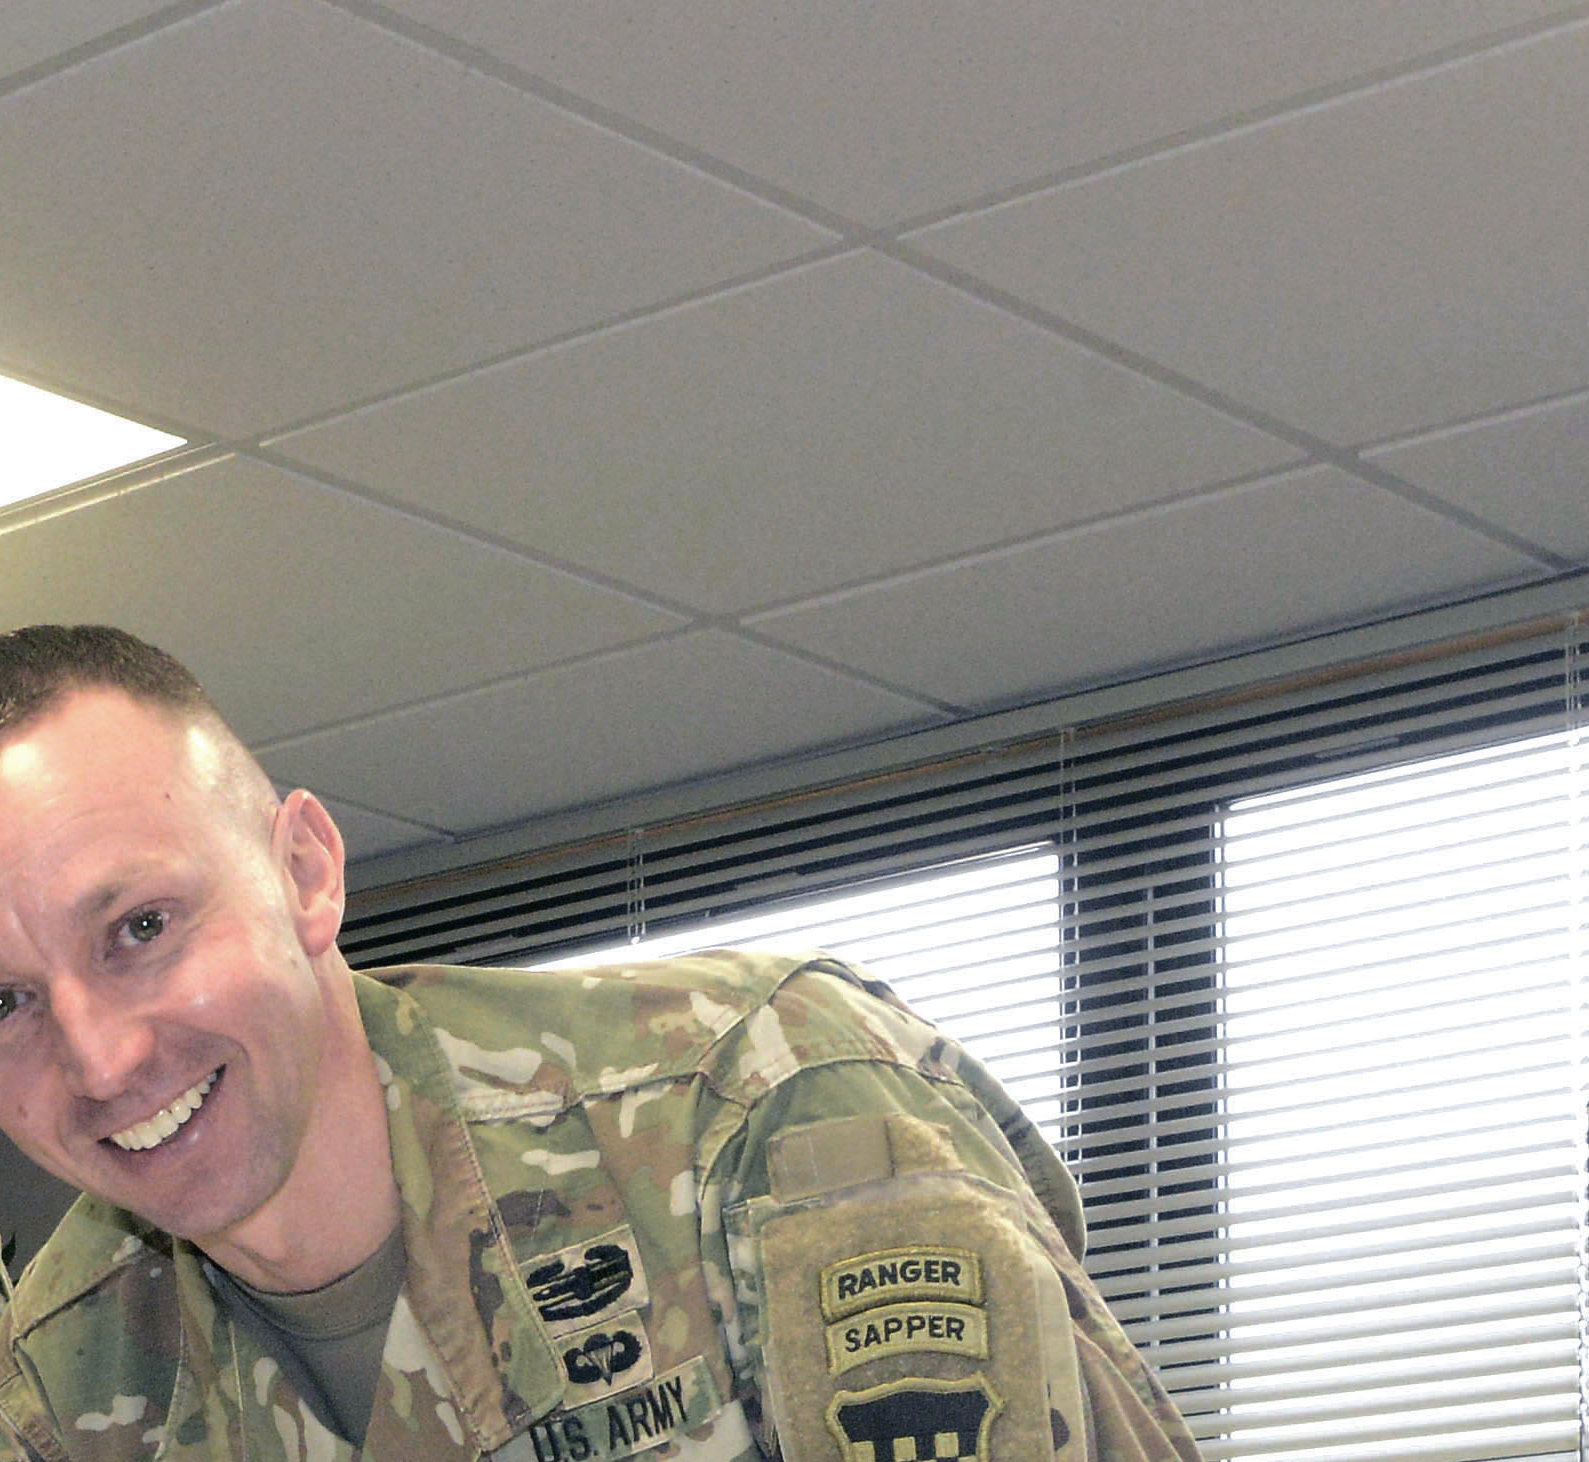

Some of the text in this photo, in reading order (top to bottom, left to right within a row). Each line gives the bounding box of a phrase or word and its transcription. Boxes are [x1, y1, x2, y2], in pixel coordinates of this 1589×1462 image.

[837, 1259, 962, 1301] RANGER
[844, 1314, 966, 1354] SAPPER
[606, 1375, 688, 1451] ARMY
